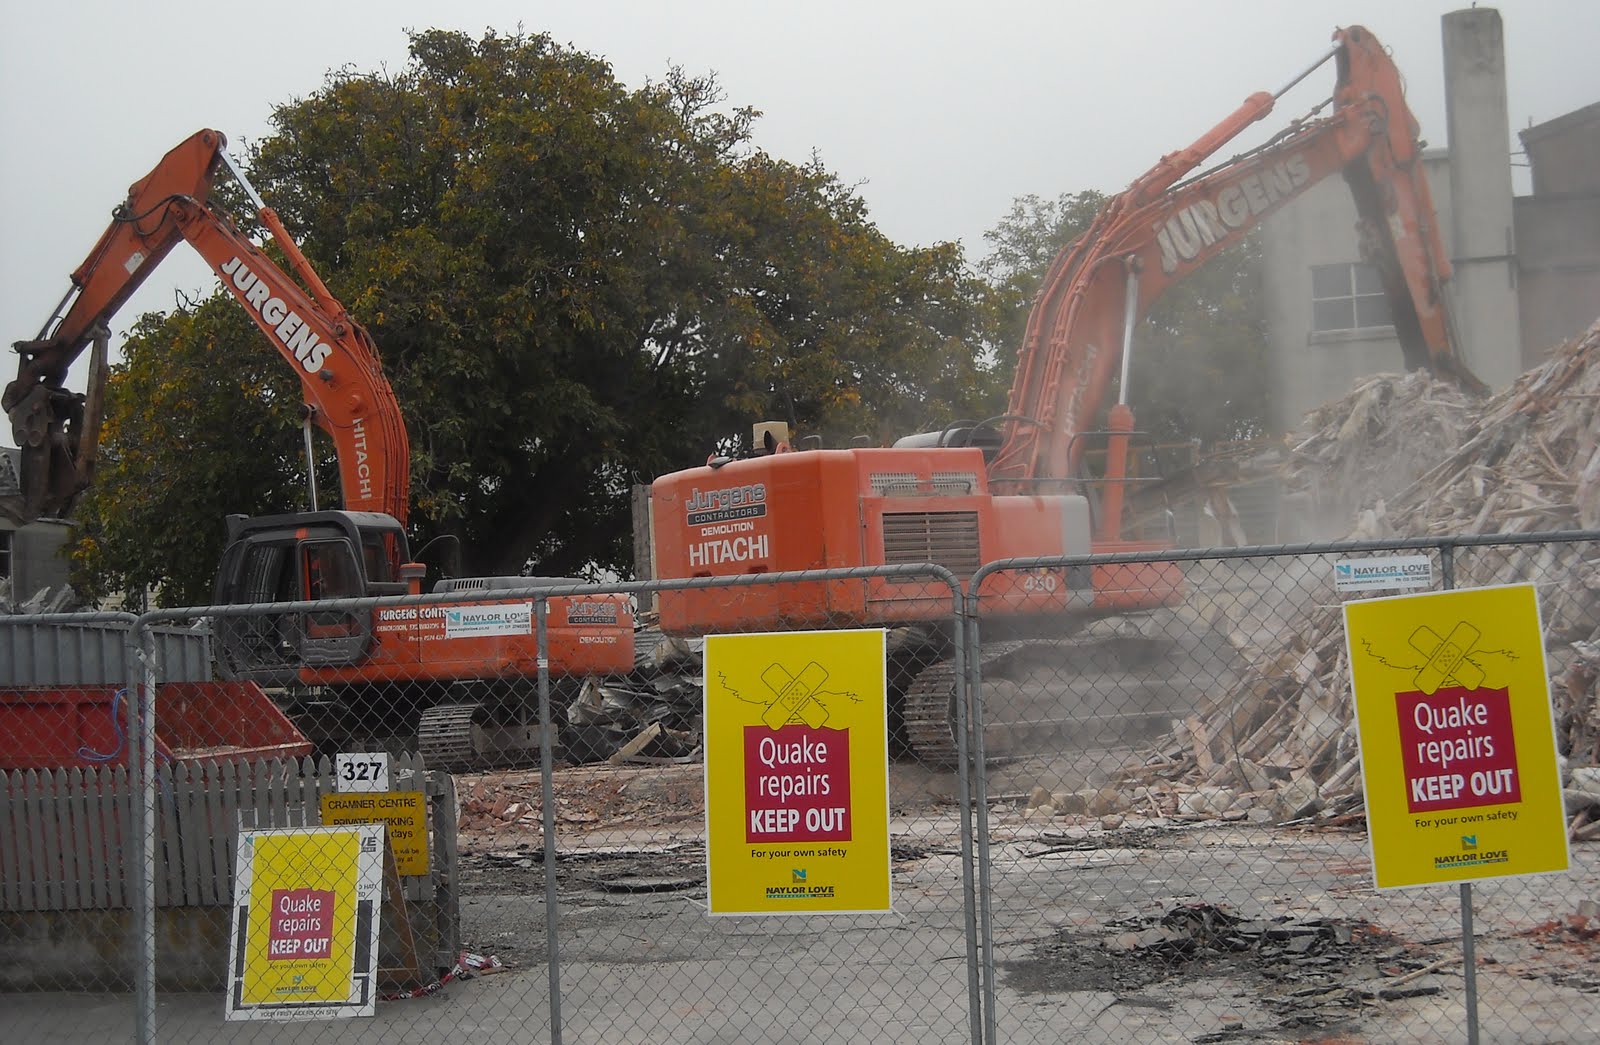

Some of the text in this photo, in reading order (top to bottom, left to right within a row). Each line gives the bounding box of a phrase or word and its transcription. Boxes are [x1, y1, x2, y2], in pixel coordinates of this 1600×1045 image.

[1152, 153, 1311, 274] JURGENS
[221, 256, 332, 373] JURGENS
[352, 417, 372, 500] HITACHI
[686, 484, 766, 511] Jurgens
[695, 508, 758, 522] CONTRACTORS
[701, 521, 753, 536] DEMOLITION
[689, 535, 769, 567] HITACHI
[1354, 565, 1397, 575] NAYLOR
[1402, 564, 1430, 572] LOVE
[379, 608, 417, 621] JURGENS
[463, 613, 500, 622] NAYLOR
[1414, 697, 1488, 734] Quake
[759, 735, 827, 769] Quake
[1417, 730, 1494, 769] repairs
[343, 762, 382, 781] 327
[759, 768, 830, 803] repairs
[1411, 768, 1513, 803] KEEP OUT
[328, 798, 416, 810] CRAMNER CENTRE
[751, 808, 846, 833] KEEP OUT
[1415, 810, 1518, 828] For your own safety
[751, 847, 847, 859] For your own safety
[1434, 850, 1508, 864] NAYLOR LOVE
[766, 886, 805, 894] NAYLOR
[280, 895, 321, 915] Quake
[279, 914, 321, 935] repairs
[271, 938, 328, 955] KEEP OUT
